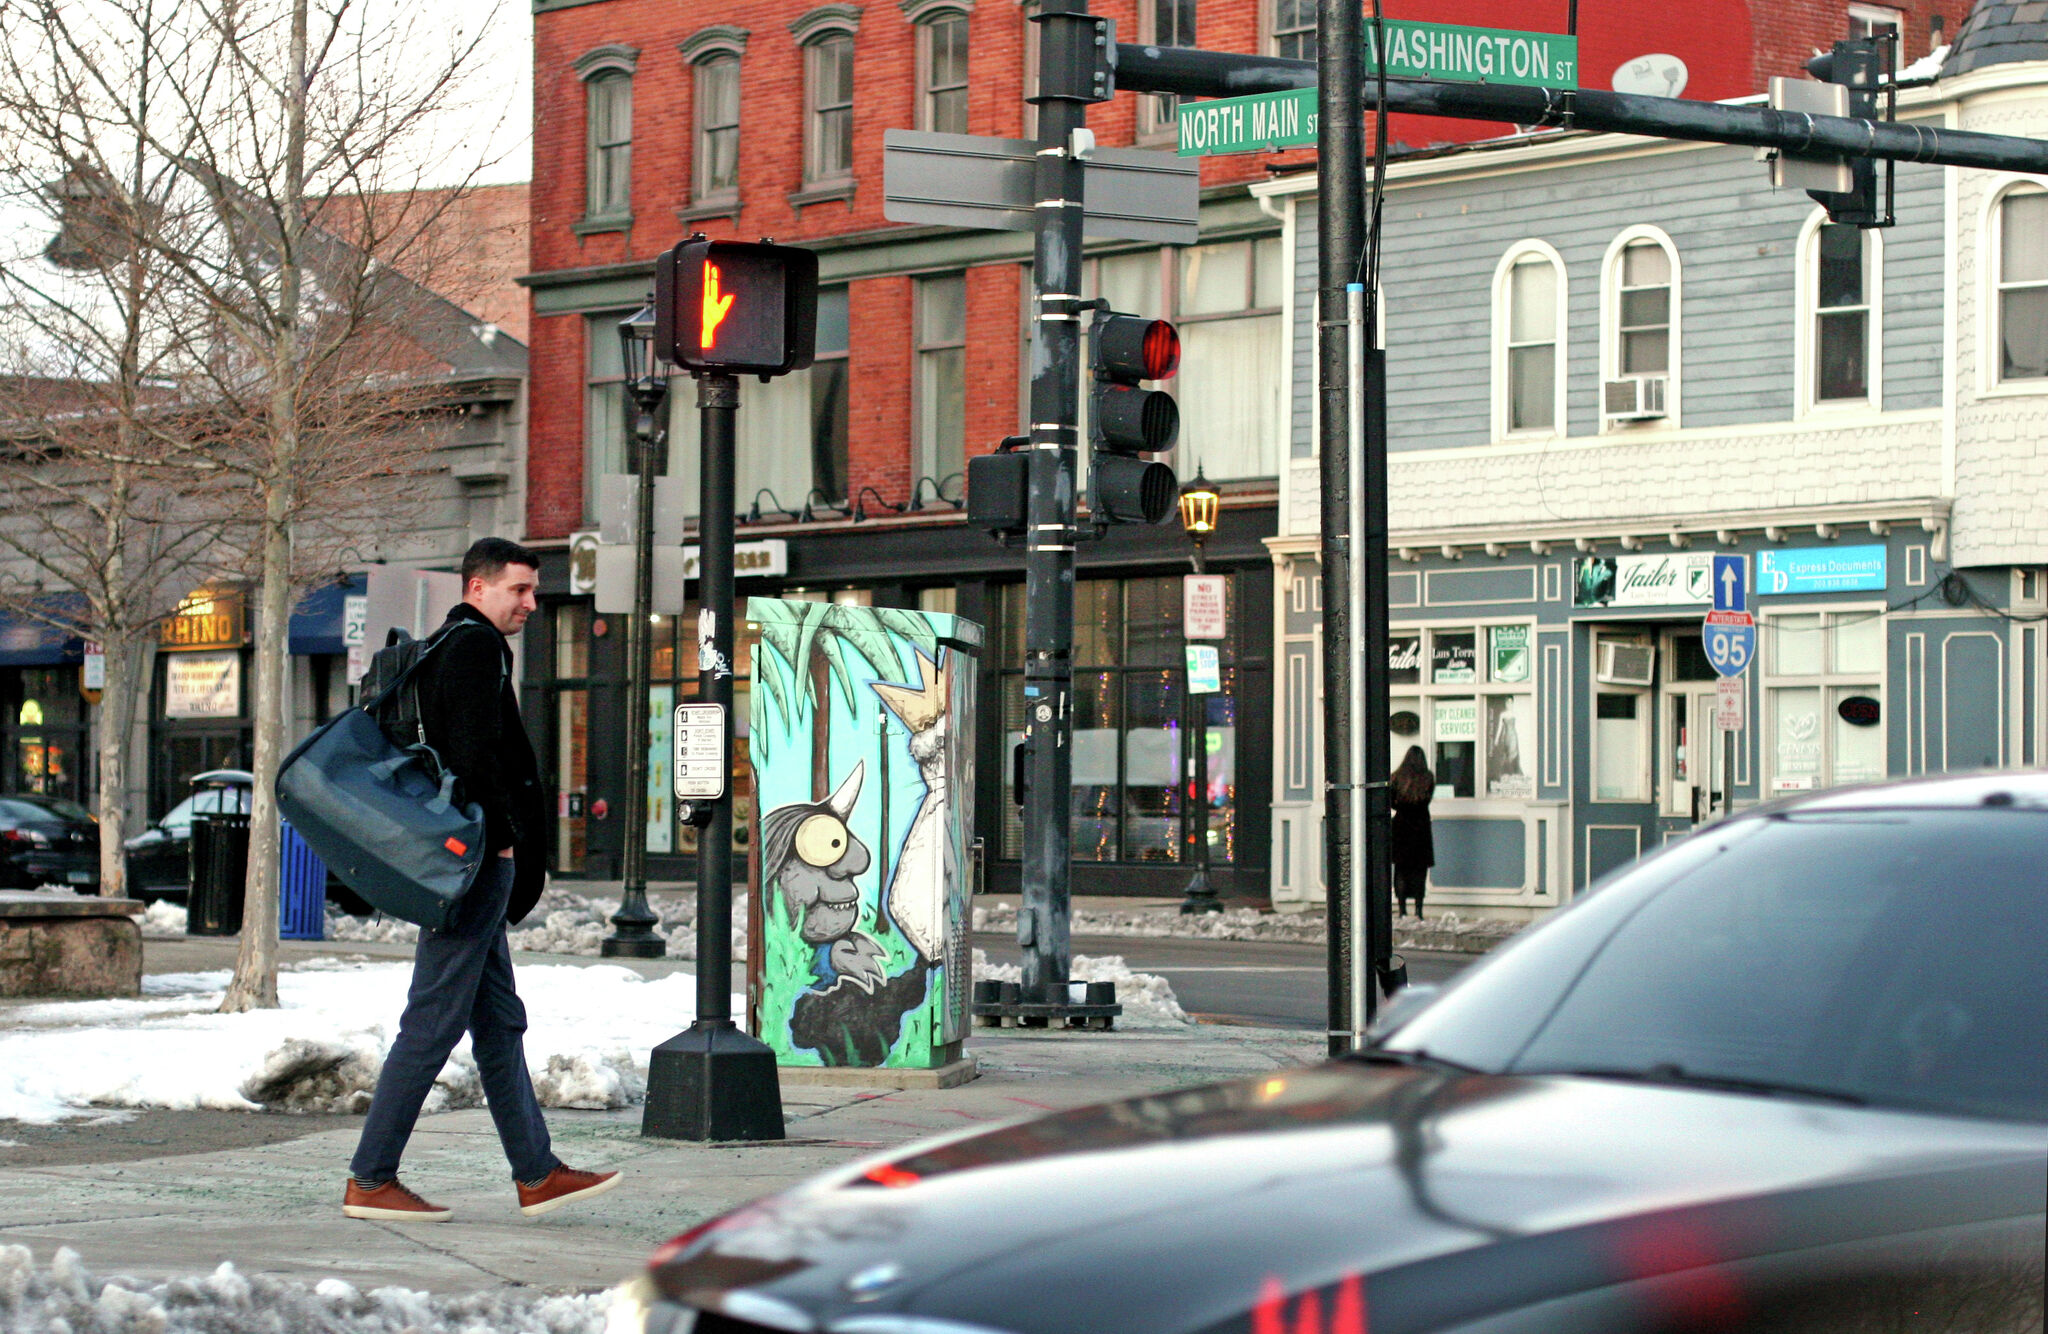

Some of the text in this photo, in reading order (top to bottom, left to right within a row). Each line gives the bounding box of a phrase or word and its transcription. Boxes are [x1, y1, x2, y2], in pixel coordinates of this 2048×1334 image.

[1368, 25, 1573, 81] WASHINGTON ST
[1181, 97, 1319, 150] NORTH MAIN ST
[1622, 557, 1678, 593] Tailor
[1789, 559, 1882, 575] Express Documents
[1197, 583, 1212, 594] NO
[1711, 614, 1748, 624] INTERSTATE
[161, 614, 232, 644] RHINO
[1432, 647, 1450, 659] Luis
[1713, 634, 1747, 667] 95
[1440, 721, 1476, 735] SERVICES
[1777, 742, 1821, 755] GENESIS
